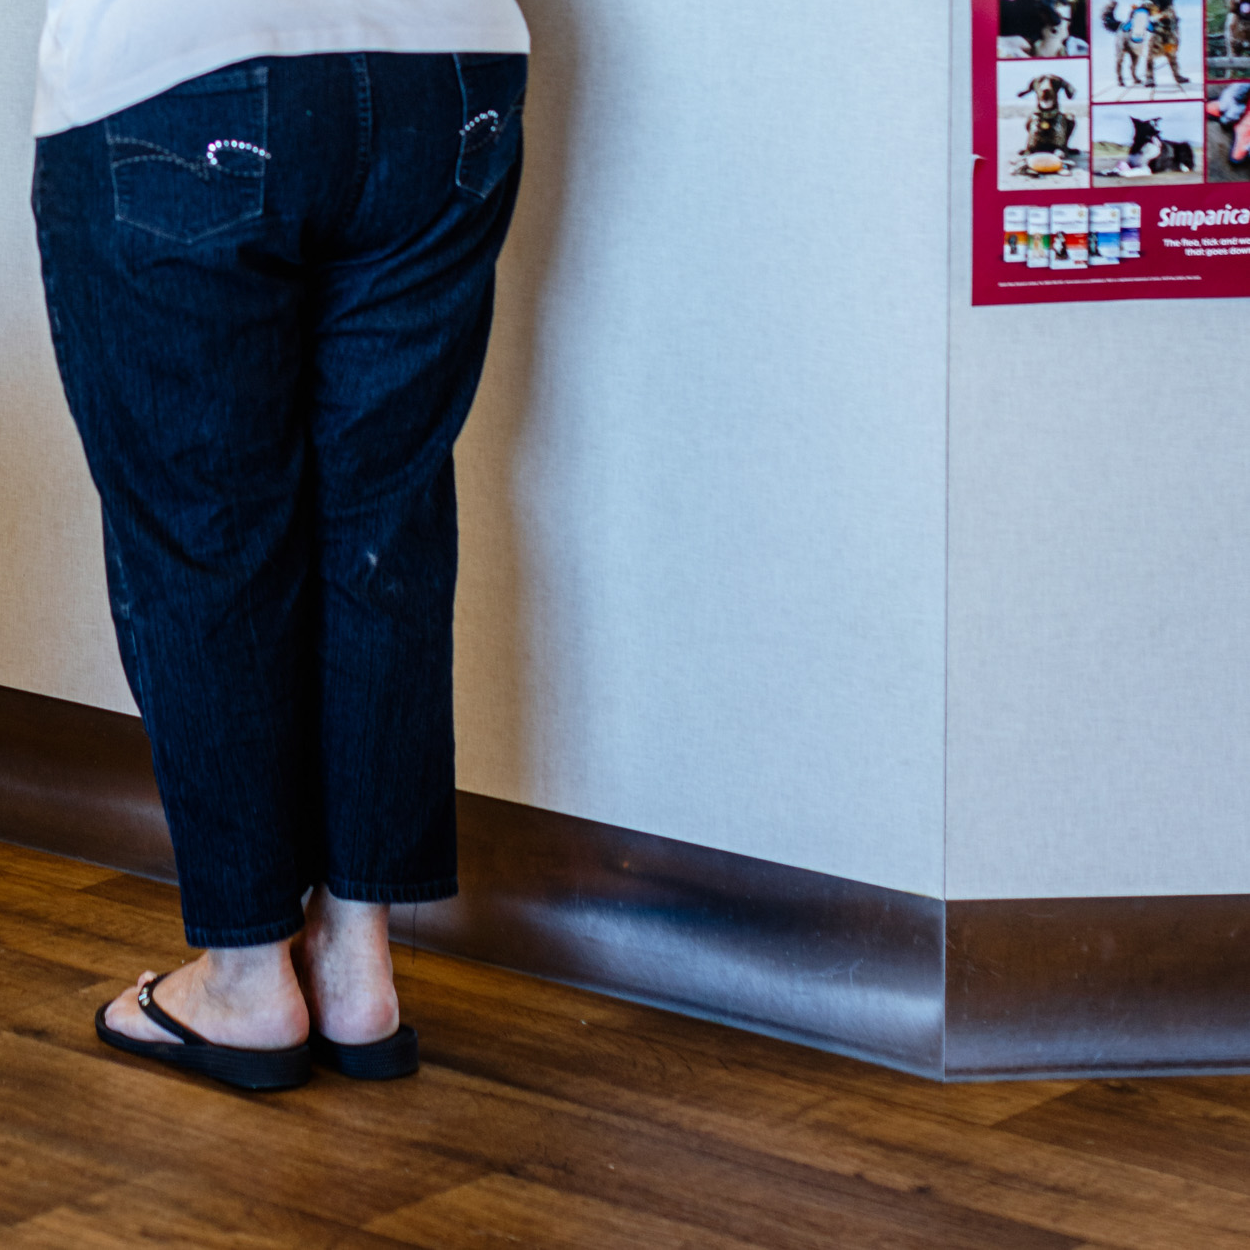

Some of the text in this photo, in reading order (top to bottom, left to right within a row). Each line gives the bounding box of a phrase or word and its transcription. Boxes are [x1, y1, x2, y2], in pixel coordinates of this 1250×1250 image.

[1157, 203, 1250, 231] Simparica
[1163, 238, 1181, 247] The
[1220, 237, 1238, 246] and
